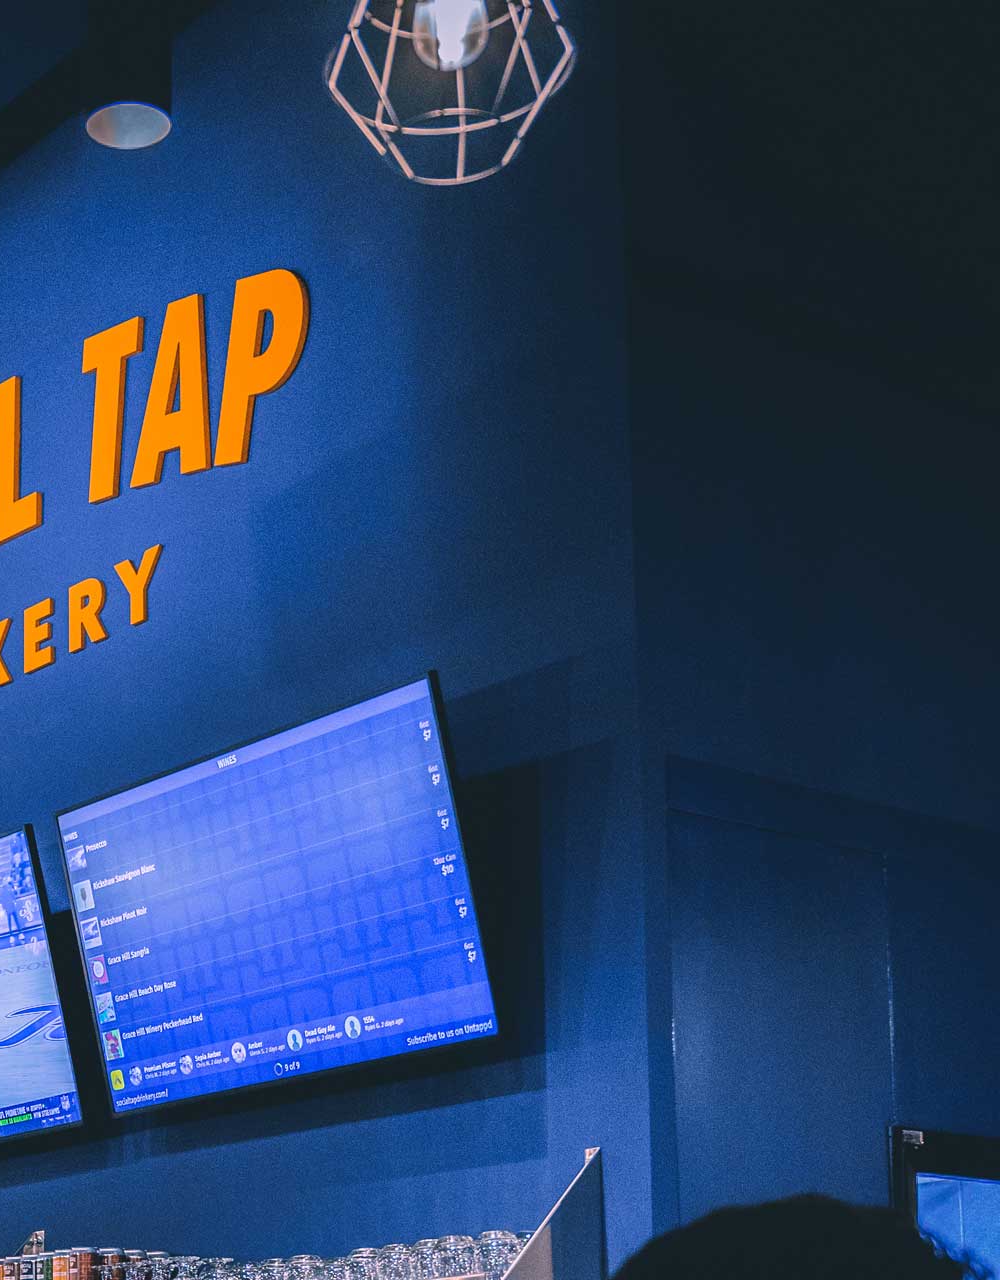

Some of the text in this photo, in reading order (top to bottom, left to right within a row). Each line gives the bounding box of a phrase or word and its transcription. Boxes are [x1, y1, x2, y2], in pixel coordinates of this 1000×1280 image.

[81, 268, 310, 504] TAP
[423, 729, 432, 742] $7
[218, 755, 237, 769] WINES
[432, 774, 441, 786] $7
[440, 818, 450, 830] $7
[86, 840, 107, 853] Prosecco
[442, 863, 454, 876] $10
[93, 864, 156, 890] Rickshaw Sauvignon Blanc
[100, 907, 147, 927] Rickshaw Pinot Noir
[459, 906, 468, 918] $7
[108, 947, 150, 965] Grace Hill Sangria
[468, 951, 477, 962] $7
[115, 981, 176, 1003] Grace Hill Beach Day Rose
[122, 1015, 203, 1040] Grace Hill Winery Peckerhead Red
[305, 1029, 317, 1037] Dead
[318, 1027, 327, 1036] Guy
[407, 1033, 437, 1046] Subscribe
[465, 1021, 493, 1035] Untappd
